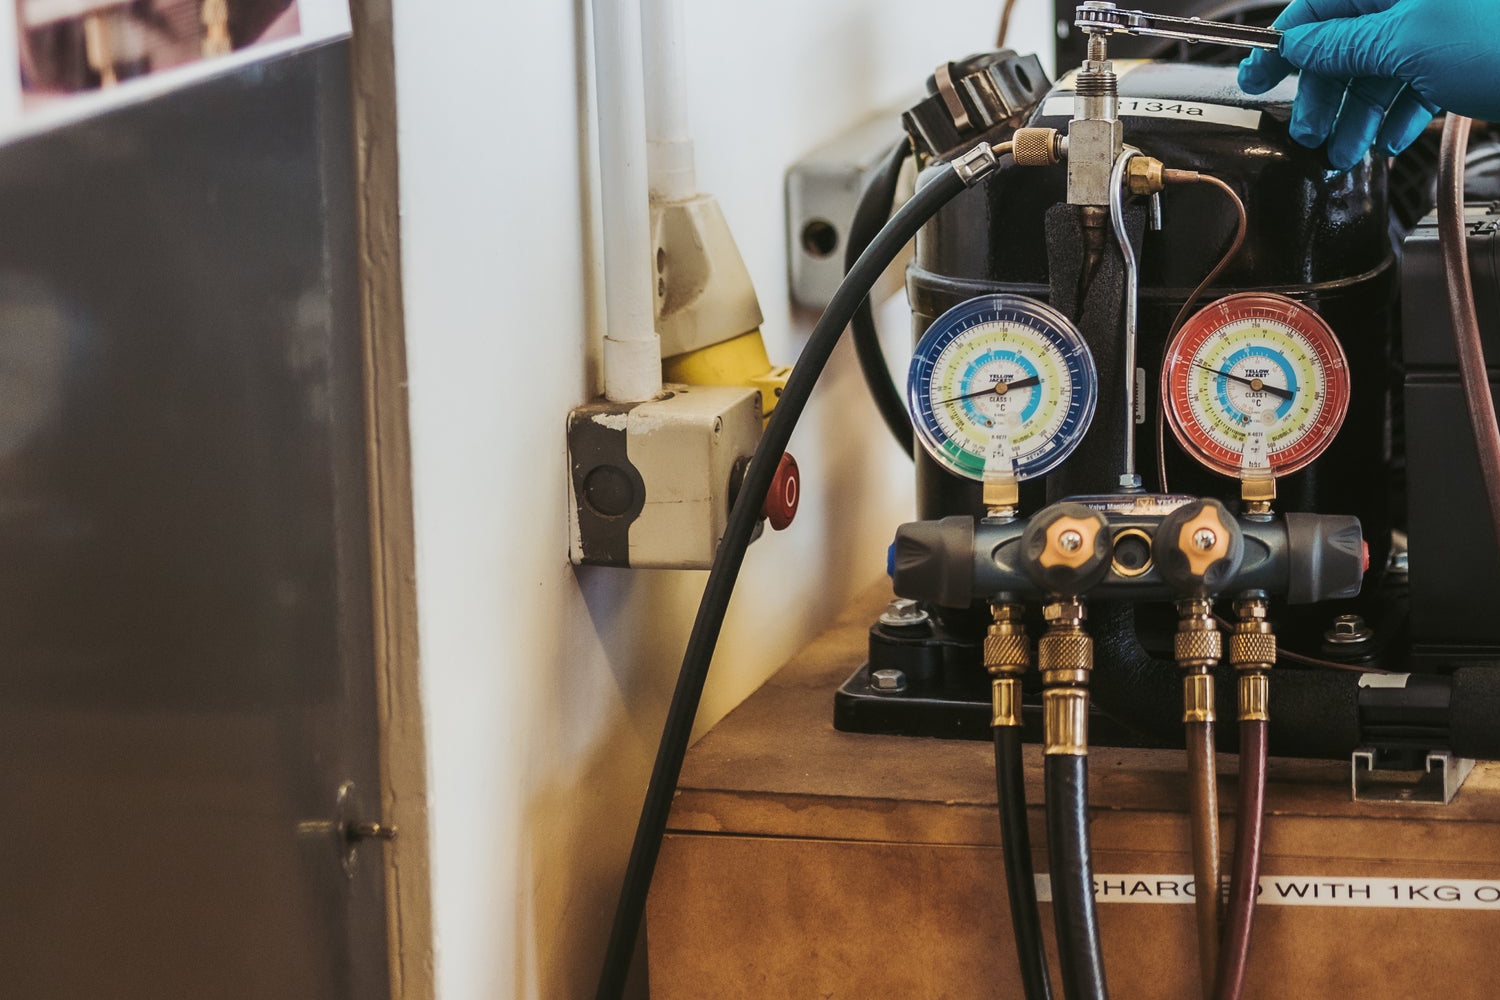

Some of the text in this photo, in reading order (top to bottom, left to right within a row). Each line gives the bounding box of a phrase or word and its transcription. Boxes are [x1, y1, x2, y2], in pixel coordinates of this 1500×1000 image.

[1117, 100, 1204, 117] 134a
[1272, 428, 1293, 442] BUBBLE
[1026, 448, 1047, 460] RETARD
[1107, 503, 1135, 511] Manifold
[1093, 880, 1263, 897] HARE
[1275, 882, 1370, 899] WITH
[1389, 885, 1461, 901] 1KG
